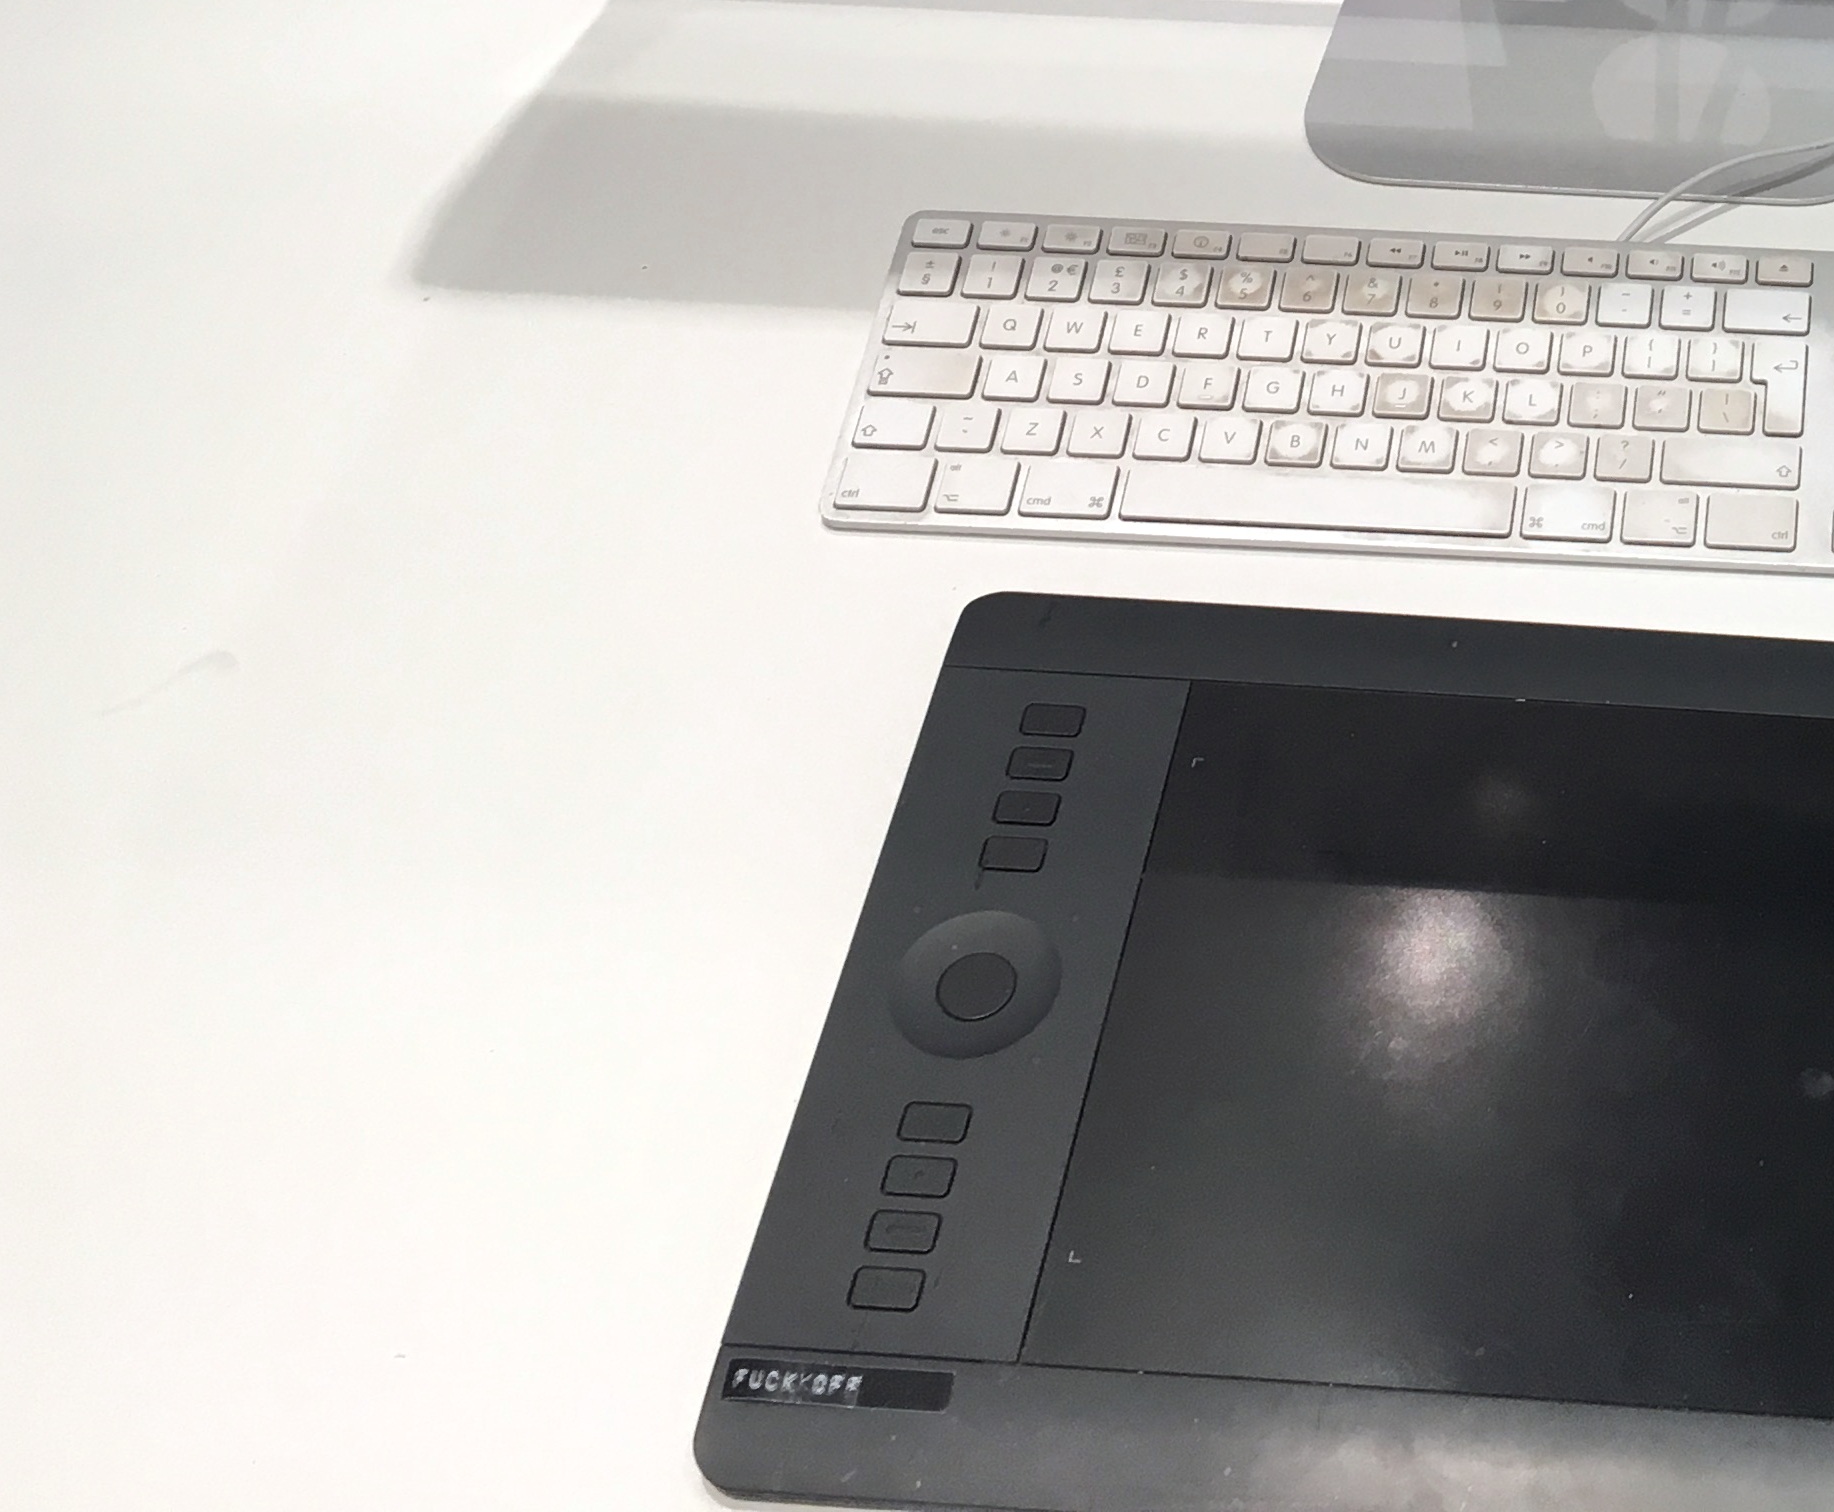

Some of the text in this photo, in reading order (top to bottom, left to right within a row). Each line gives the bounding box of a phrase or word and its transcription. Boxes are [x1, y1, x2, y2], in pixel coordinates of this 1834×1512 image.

[1115, 266, 1125, 277] £
[1180, 269, 1188, 280] $
[1240, 271, 1254, 283] %
[1367, 278, 1378, 289] &
[987, 276, 992, 288] 1
[1048, 280, 1058, 291] 2
[1111, 282, 1120, 294] 3
[1176, 286, 1184, 297] 4
[1238, 288, 1247, 300] 5
[1303, 291, 1312, 302] 6
[1367, 293, 1376, 305] 7
[1429, 297, 1438, 308] 8
[1493, 300, 1502, 310] 9
[1556, 303, 1566, 314] 0
[1003, 319, 1016, 331] Q
[1067, 322, 1083, 333] W
[1134, 324, 1144, 337] E
[1198, 328, 1208, 339] R
[1264, 331, 1272, 342] T
[1327, 334, 1336, 345] Y
[1389, 337, 1401, 349] U
[1516, 342, 1529, 354] O
[1583, 345, 1592, 357] P
[1006, 370, 1536, 406] A S D F G H J K L
[1026, 423, 1435, 453] Z X C V B N M
[1621, 440, 1629, 449] ?
[841, 488, 1788, 539] ctrl cmd cmd ctrl
[732, 1368, 798, 1392] FUCK
